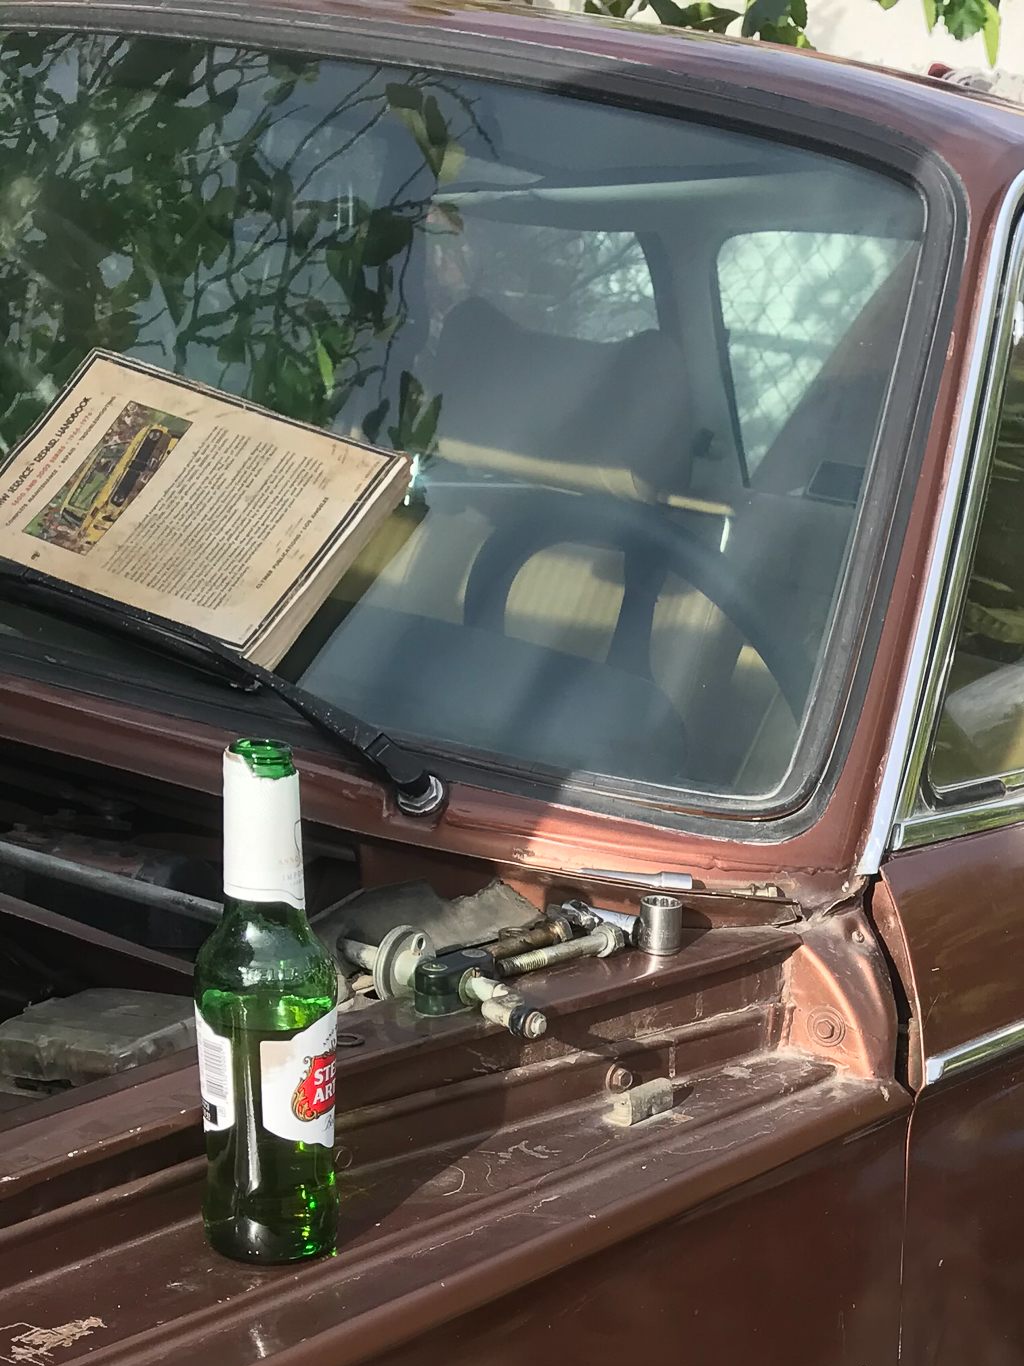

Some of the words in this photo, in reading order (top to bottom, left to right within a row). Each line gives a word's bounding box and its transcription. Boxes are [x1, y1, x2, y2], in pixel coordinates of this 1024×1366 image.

[7, 466, 34, 493] SERVICE
[34, 438, 59, 463] REPAIR
[55, 397, 92, 437] HANDBOOK
[26, 479, 38, 493] AND
[50, 446, 66, 464] SERIES
[256, 569, 273, 590] CLYMER
[272, 534, 302, 570] PUBLICATIONS
[311, 496, 330, 519] ANGELES
